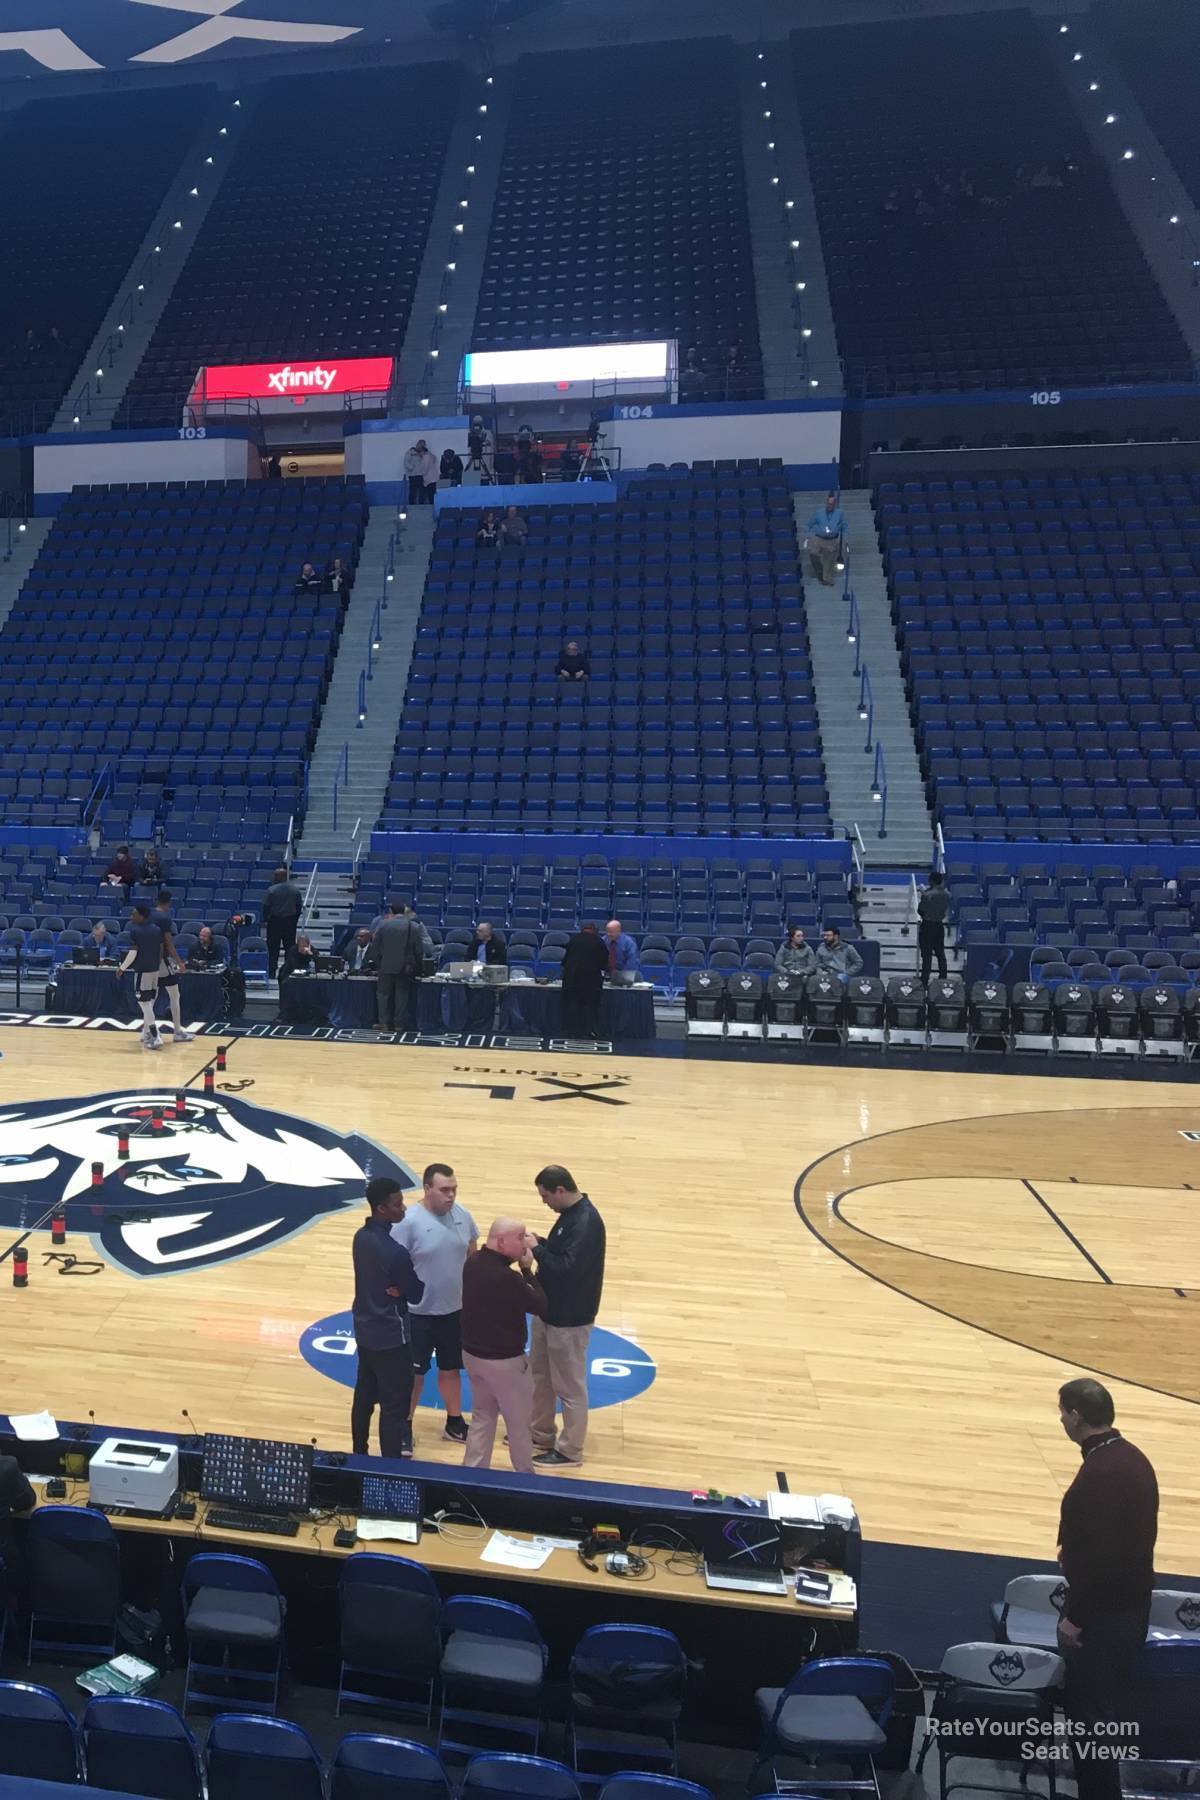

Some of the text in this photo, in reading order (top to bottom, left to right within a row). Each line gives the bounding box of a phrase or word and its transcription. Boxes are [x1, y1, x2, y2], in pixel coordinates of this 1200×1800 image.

[267, 366, 337, 392] xfinity
[1030, 391, 1061, 405] 105
[620, 406, 654, 418] 104
[178, 427, 206, 439] 103
[204, 1022, 613, 1053] HUSKIES
[452, 1066, 632, 1081] XL CENTER
[443, 1077, 631, 1106] XL
